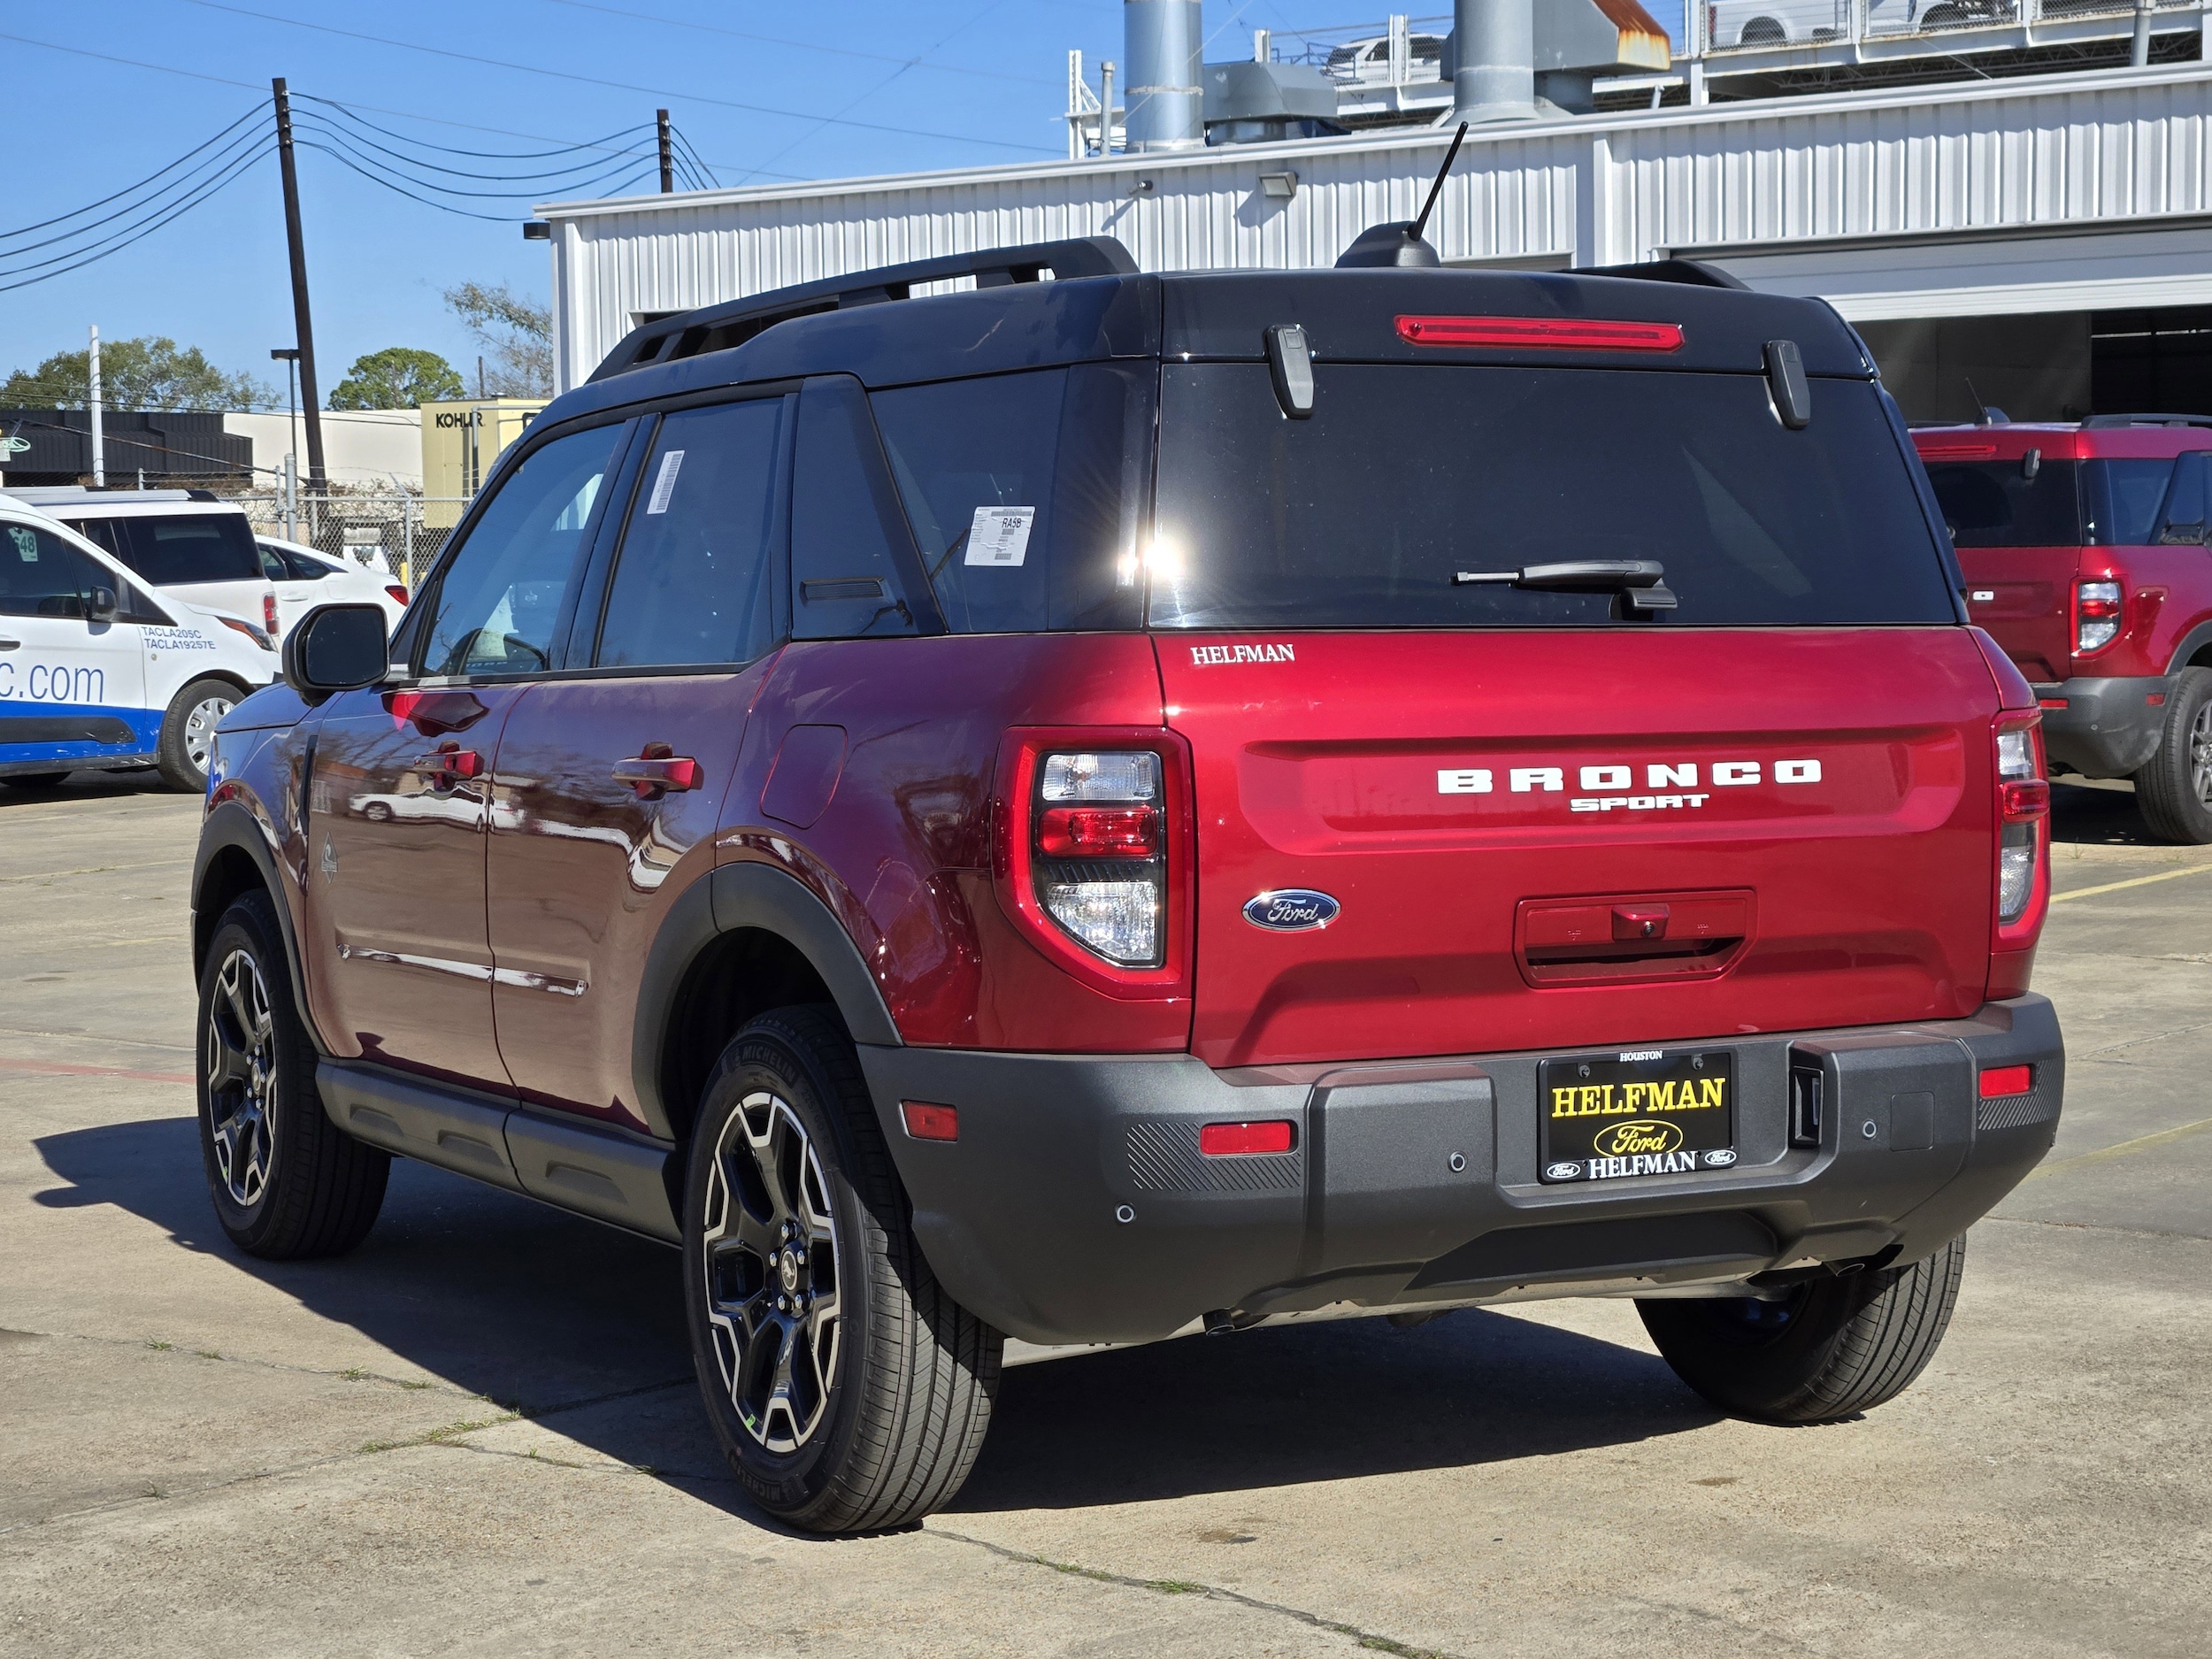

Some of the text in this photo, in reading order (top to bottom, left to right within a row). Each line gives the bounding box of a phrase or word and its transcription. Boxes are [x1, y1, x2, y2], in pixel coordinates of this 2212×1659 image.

[1002, 517, 1022, 528] RA5B
[142, 626, 202, 639] TACLA205C
[144, 638, 216, 649] TACLA19257E
[1190, 643, 1295, 664] HELFMAN
[0, 662, 104, 703] c.com
[1437, 759, 1822, 794] BRONCO
[1571, 794, 1709, 812] SPORT
[1267, 898, 1319, 922] Ford
[742, 1045, 795, 1081] MICHELIN
[1620, 1050, 1663, 1062] HOUSTON
[1552, 1078, 1725, 1118] HELFMAN
[1612, 1125, 1668, 1153] Ford
[1553, 1151, 1731, 1179] Ford HELFMAN Ford
